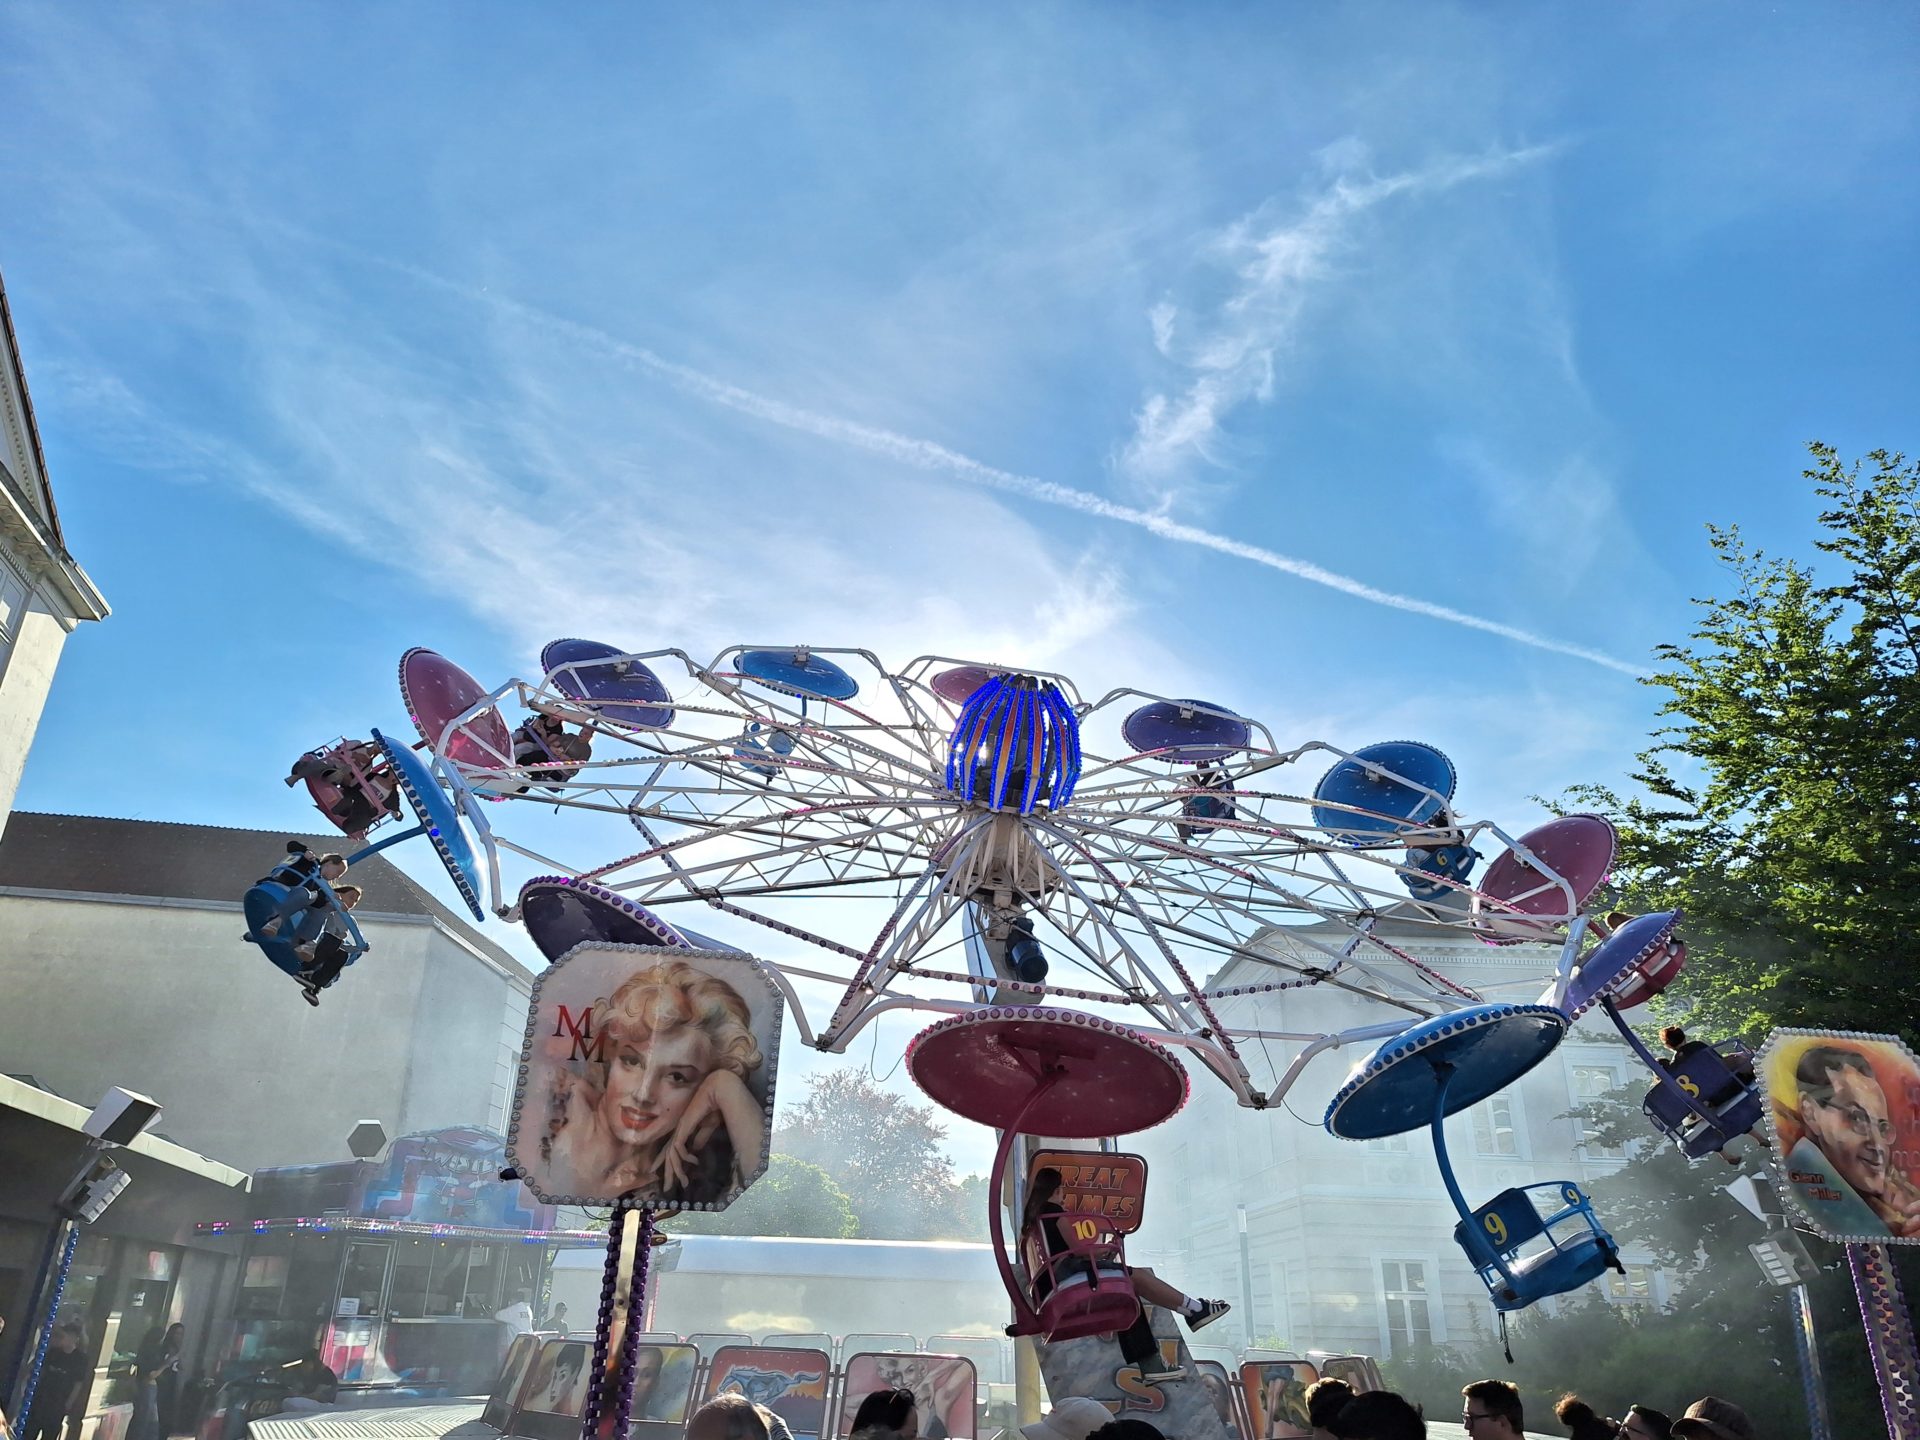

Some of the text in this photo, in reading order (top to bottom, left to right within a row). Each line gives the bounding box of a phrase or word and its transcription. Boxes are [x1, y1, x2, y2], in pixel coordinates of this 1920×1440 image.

[1044, 1165, 1130, 1191] REAT
[1788, 1169, 1825, 1184] Glenn
[1565, 1188, 1581, 1206] 9
[1808, 1187, 1842, 1201] Miller
[1061, 1193, 1136, 1218] AMES
[1072, 1219, 1097, 1241] 10
[1483, 1211, 1509, 1246] 9
